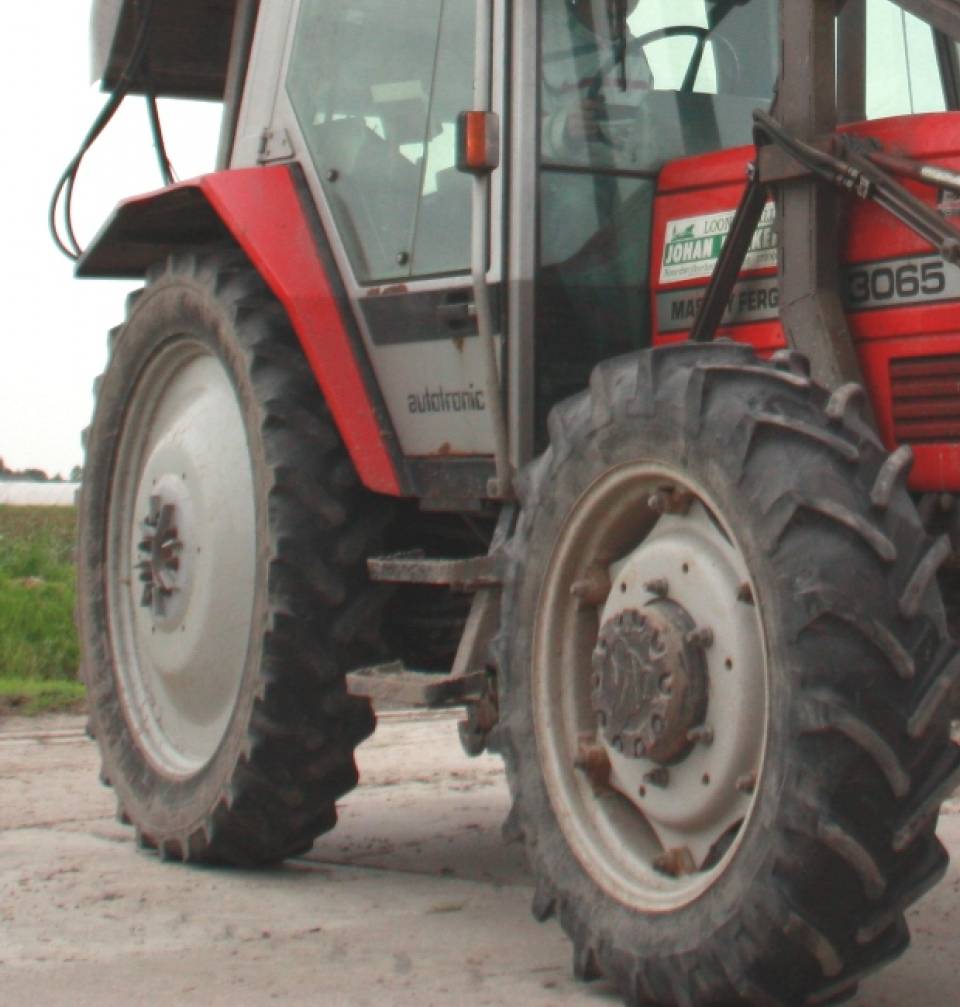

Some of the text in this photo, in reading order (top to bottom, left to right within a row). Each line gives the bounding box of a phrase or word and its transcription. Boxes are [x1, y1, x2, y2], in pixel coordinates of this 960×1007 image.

[665, 237, 713, 264] JOHAN
[848, 261, 945, 303] 3065
[407, 383, 486, 414] autotronic
